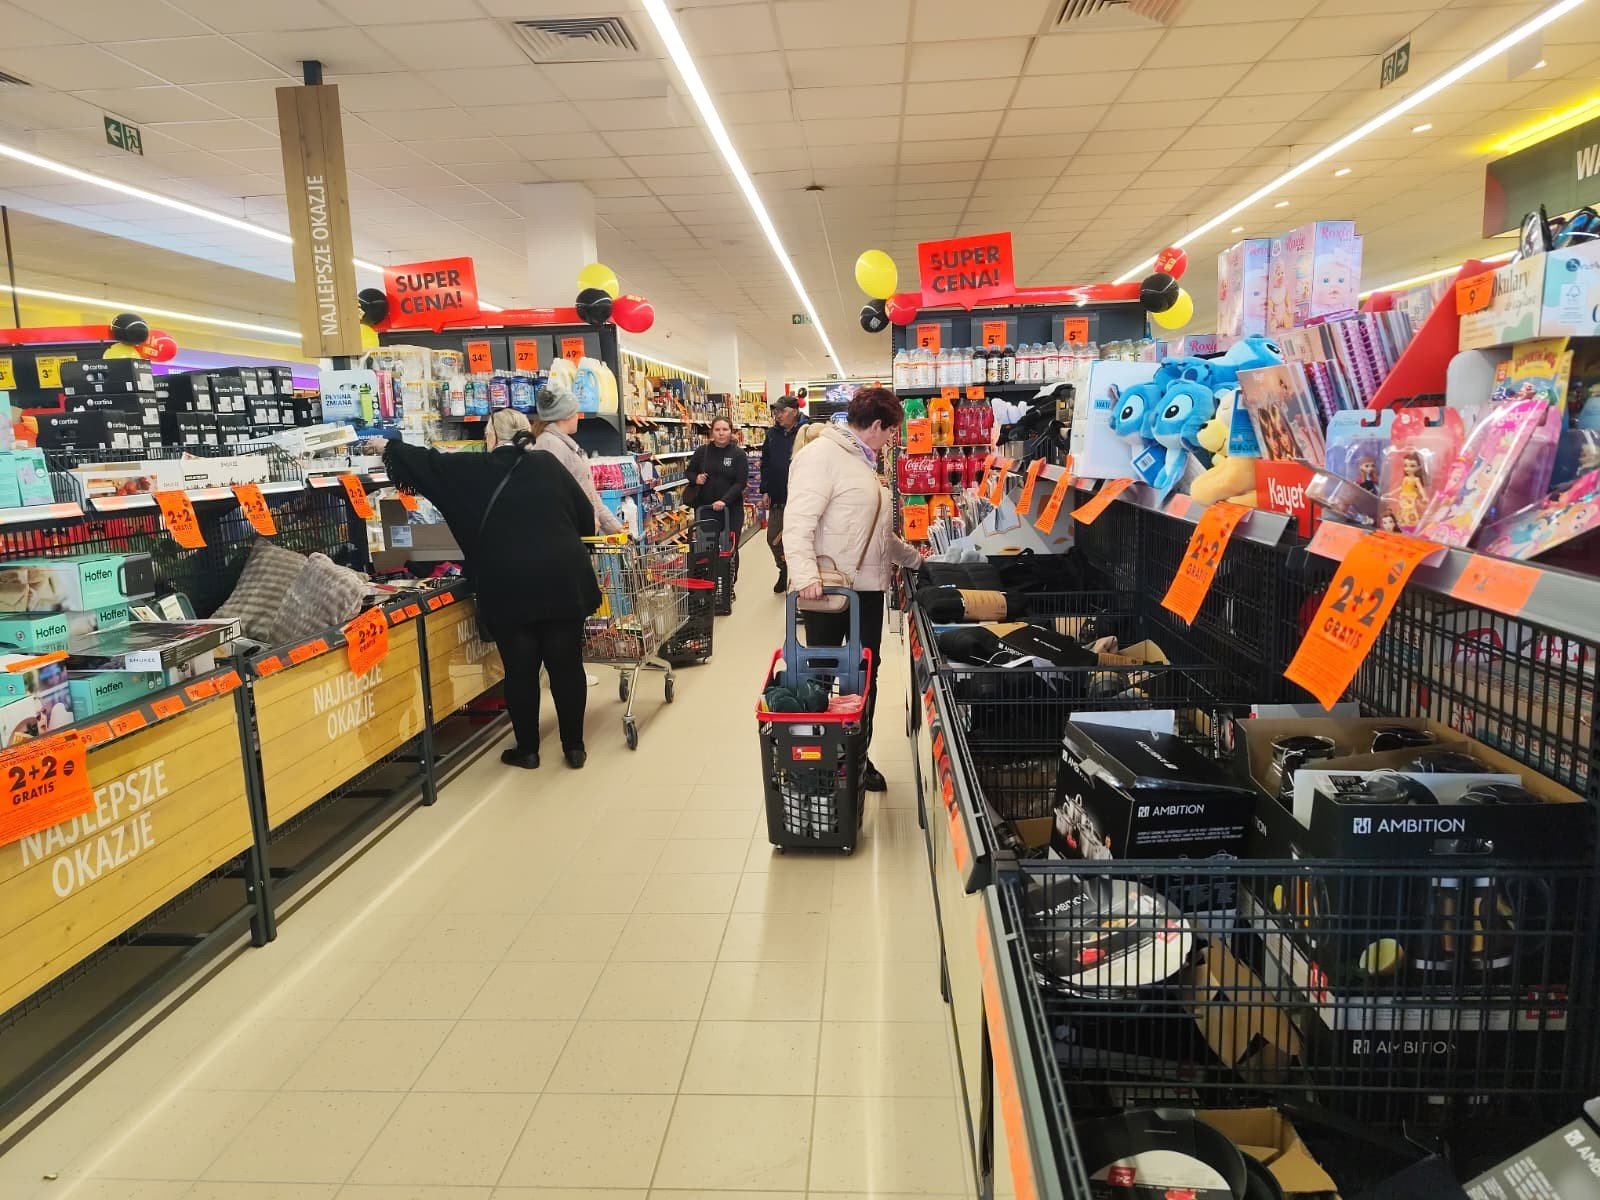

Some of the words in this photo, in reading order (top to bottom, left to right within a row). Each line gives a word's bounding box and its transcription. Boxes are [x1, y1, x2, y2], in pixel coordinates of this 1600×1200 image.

[307, 174, 329, 242] OKAZJE
[929, 245, 1000, 270] SUPER
[314, 245, 338, 337] NAJLEPSZE
[396, 269, 461, 293] SUPER
[932, 268, 999, 294] CENA!
[400, 291, 464, 315] CENA!
[1267, 477, 1306, 514] Kayet
[167, 508, 192, 525] 2+2
[1191, 533, 1220, 567] 2+2
[85, 568, 113, 583] Hoffen
[1329, 575, 1386, 627] 2+2
[100, 608, 128, 623] Hoffen
[36, 623, 68, 640] Hoffen
[359, 622, 377, 645] 2+2
[1323, 616, 1364, 650] GRATIS
[96, 680, 124, 697] Hoffen
[313, 664, 383, 715] NAJLEPSZE
[327, 693, 376, 740] OKAZJE
[8, 755, 58, 793] 2+2
[19, 759, 169, 868] NAJLEPSZE
[1152, 804, 1206, 817] AMBITION
[1377, 818, 1466, 833] AMBITION
[52, 811, 156, 898] OKAZJE
[1376, 1040, 1457, 1055] ABITIO
